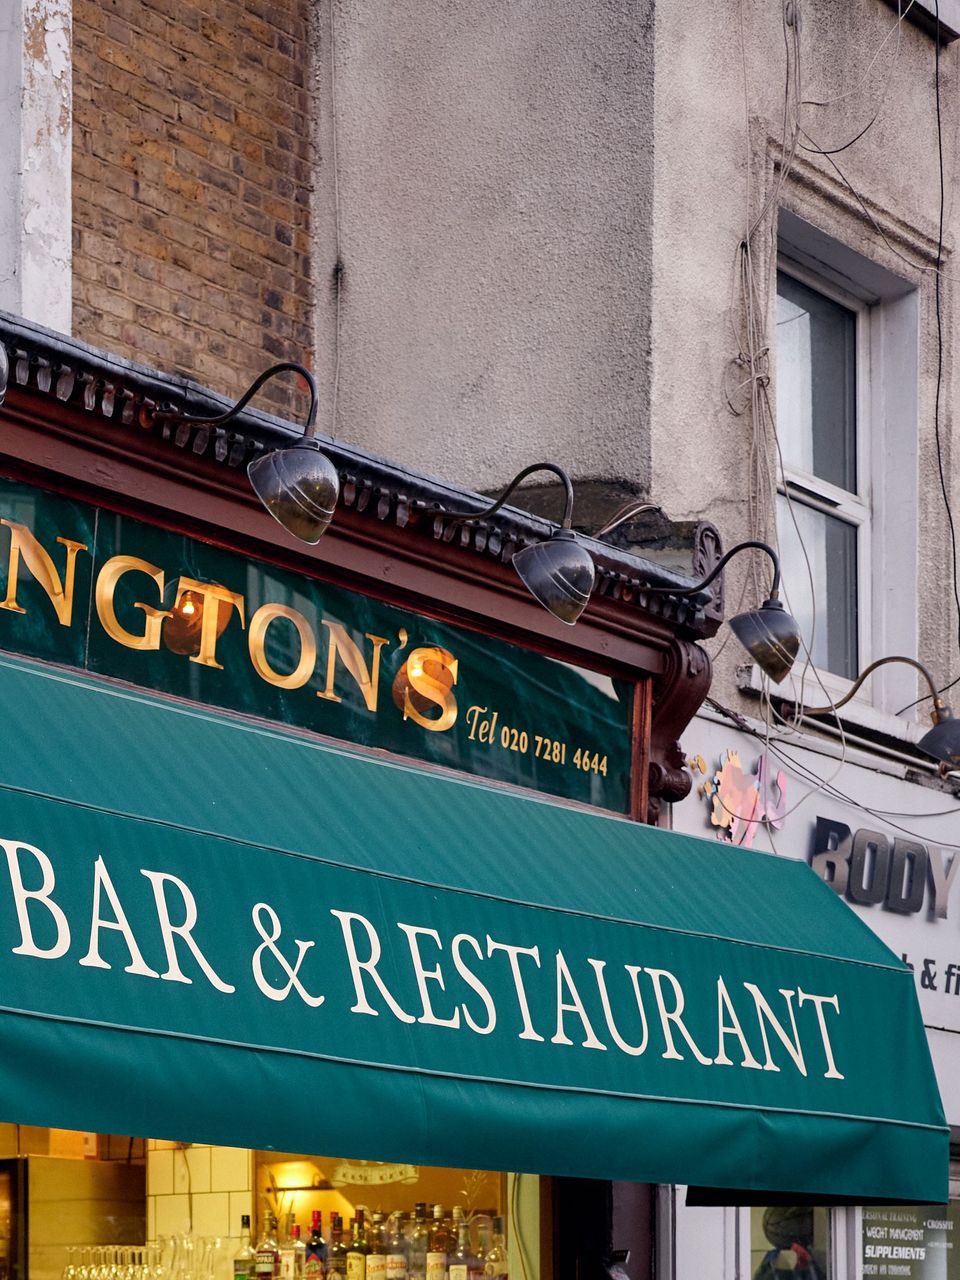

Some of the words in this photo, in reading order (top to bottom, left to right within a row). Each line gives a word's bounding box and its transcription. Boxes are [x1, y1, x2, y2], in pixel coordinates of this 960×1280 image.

[466, 706, 499, 746] Tel
[500, 726, 528, 754] 020
[534, 735, 566, 765] 7281
[573, 747, 608, 777] 4644
[811, 815, 960, 920] BODY
[251, 903, 325, 1007] &
[330, 909, 844, 1080] RESTAURANT
[921, 958, 937, 991] &
[865, 1245, 926, 1260] SUPPLEMENTS
